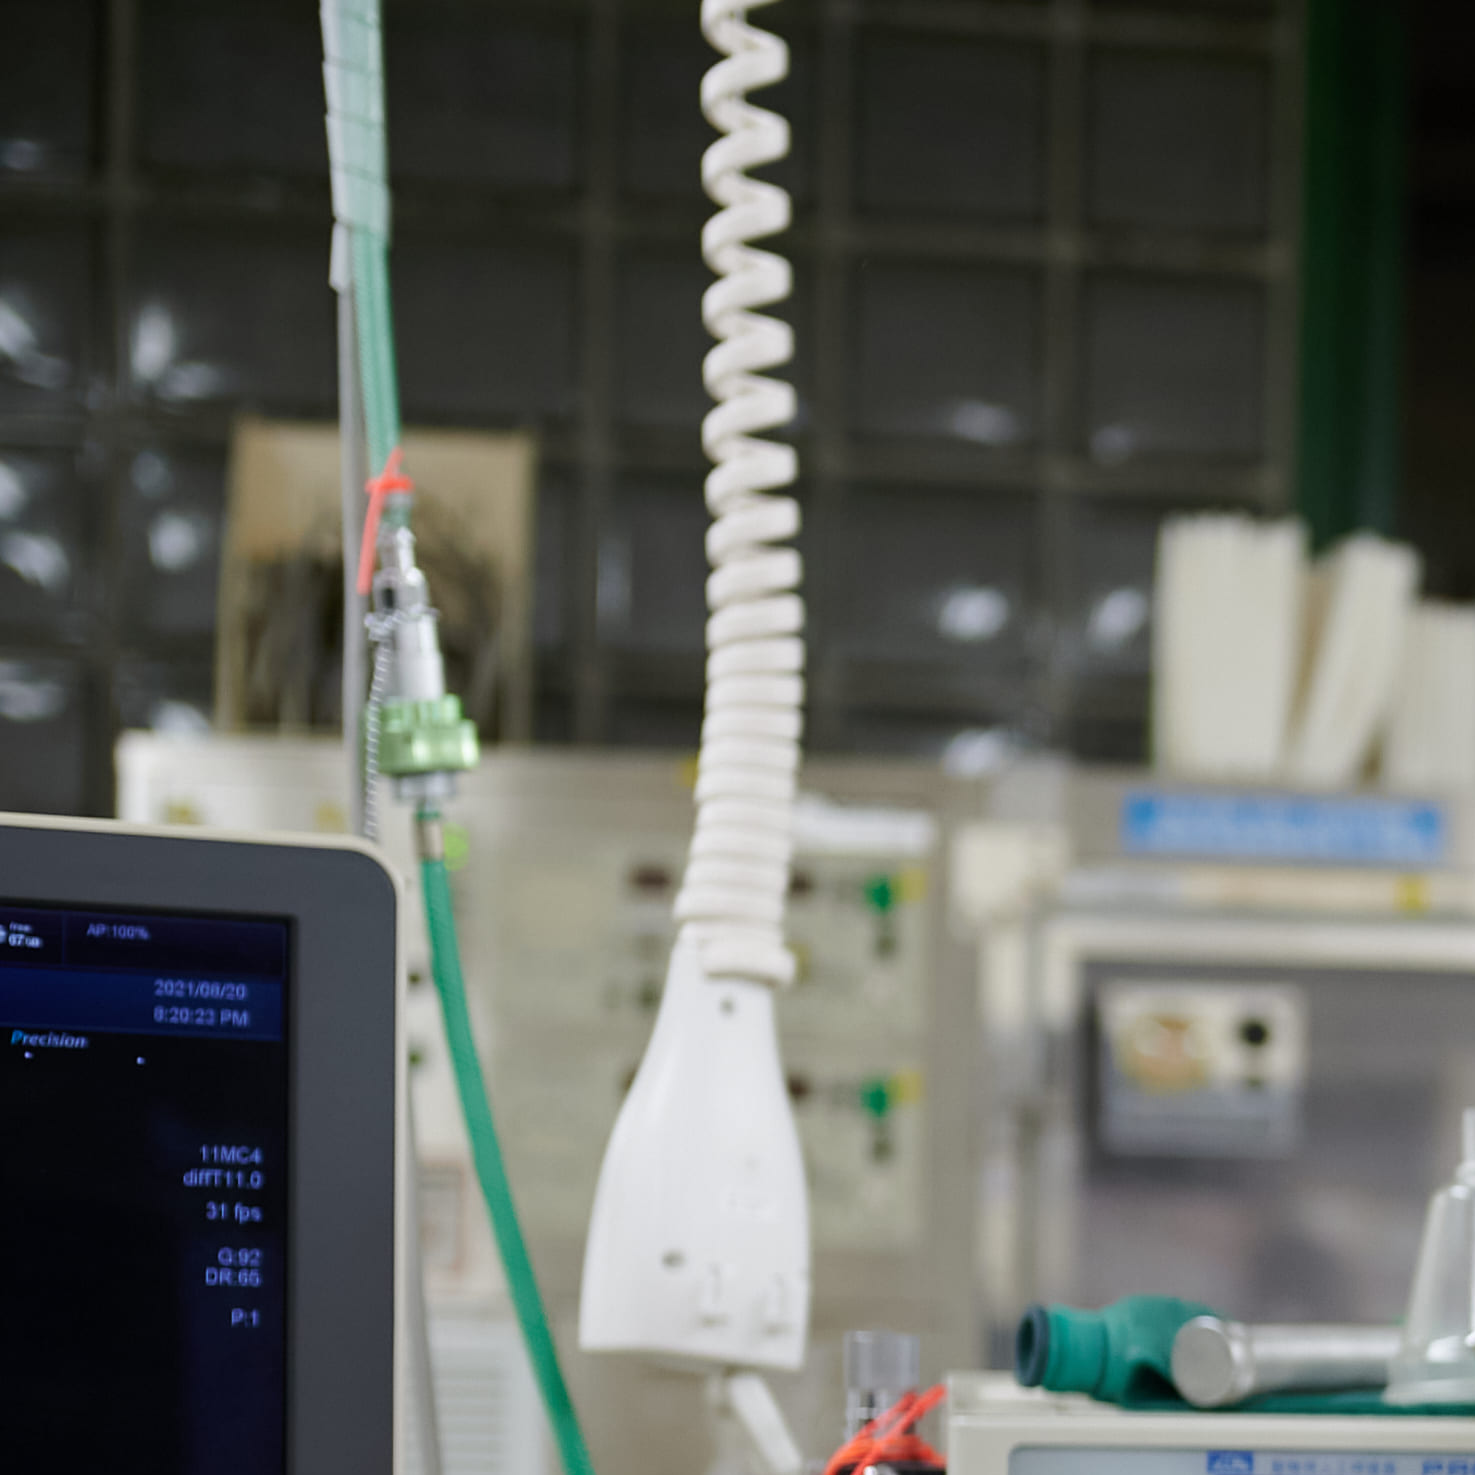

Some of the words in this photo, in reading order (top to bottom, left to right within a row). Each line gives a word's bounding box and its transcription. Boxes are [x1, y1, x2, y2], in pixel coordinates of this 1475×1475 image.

[219, 1008, 249, 1028] PM
[11, 1029, 88, 1049] Precision
[201, 1144, 263, 1165] 11MC4
[206, 1201, 227, 1221] 31
[234, 1202, 263, 1225] fps
